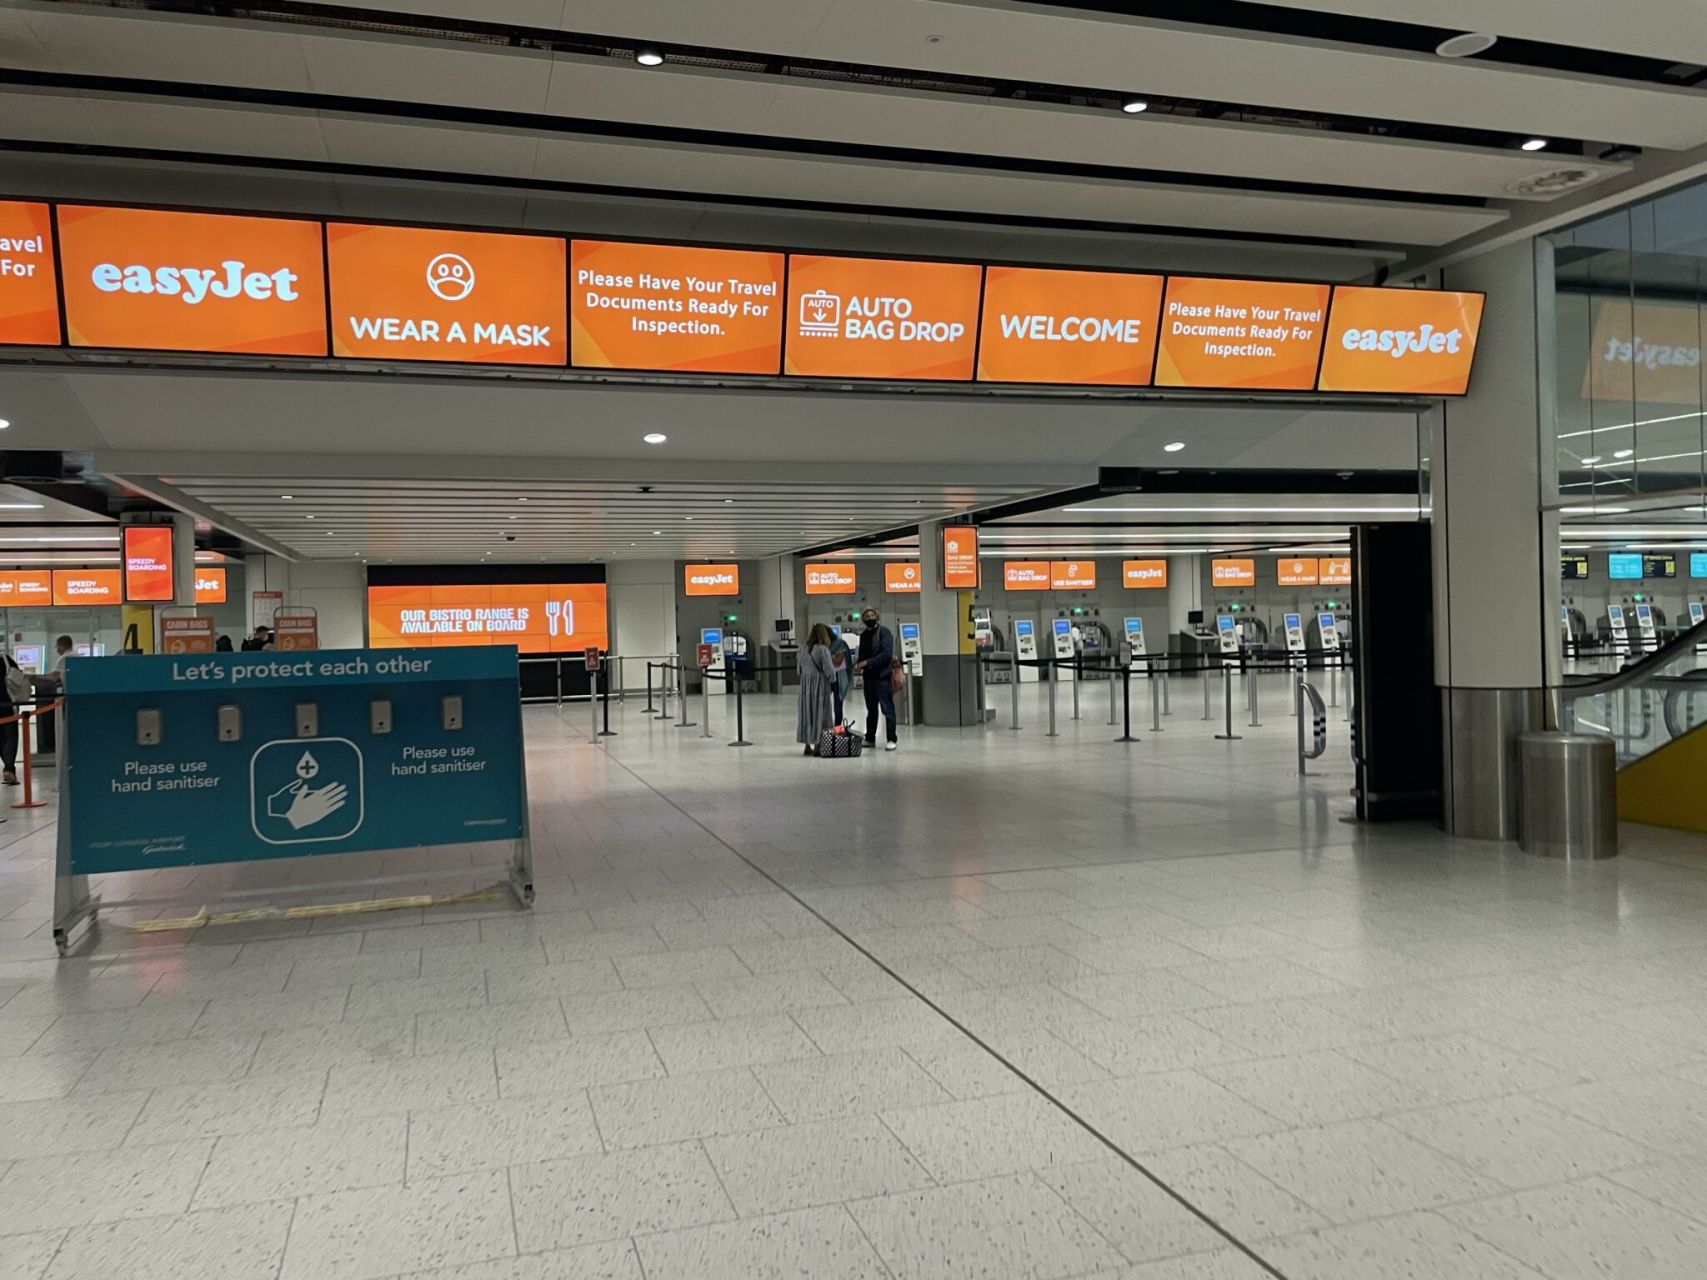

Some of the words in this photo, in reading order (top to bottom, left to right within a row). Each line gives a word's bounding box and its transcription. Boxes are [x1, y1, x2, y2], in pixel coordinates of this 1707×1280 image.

[0, 236, 42, 252] avel
[1, 259, 35, 276] For
[92, 261, 298, 304] easyJet
[578, 270, 633, 288] Please
[639, 274, 680, 290] Have
[686, 276, 723, 293] Your
[728, 279, 777, 296] Travel
[586, 292, 683, 312] Documents
[688, 298, 738, 318] Ready
[743, 302, 769, 317] For
[808, 300, 834, 308] AUTO
[846, 296, 912, 318] AUTO
[1168, 302, 1211, 317] Please
[1214, 304, 1247, 319] Have
[1251, 306, 1280, 320] Your
[1284, 308, 1321, 322] Travel
[350, 317, 440, 342] WEAR
[446, 322, 466, 343] A
[474, 323, 550, 347] MASK
[632, 316, 726, 335] Inspection.
[846, 318, 894, 340] BAG
[900, 321, 964, 342] DROP
[1000, 314, 1140, 344] WELCOME
[1172, 322, 1246, 338] Documents
[1250, 325, 1288, 342] Ready
[1292, 327, 1312, 340] For
[1204, 342, 1276, 358] Inspection.
[1342, 324, 1462, 358] easyJet
[67, 586, 109, 594] BOARDING
[400, 610, 426, 621] OUR
[430, 609, 472, 621] BISTRO
[476, 608, 514, 620] RANGE
[518, 608, 529, 619] IS
[400, 621, 464, 634] AVAILABLE
[466, 620, 483, 632] ON
[486, 620, 526, 632] BOARD
[172, 662, 225, 680] Let's
[232, 662, 313, 684] protect
[320, 657, 368, 676] each
[376, 655, 432, 674] other
[402, 746, 447, 760] Please
[451, 746, 476, 757] use
[124, 760, 176, 776] Please
[180, 761, 208, 772] use
[392, 760, 427, 776] hand
[431, 759, 486, 774] sanitiser
[112, 777, 152, 792] hand
[156, 775, 220, 790] sanitiser
